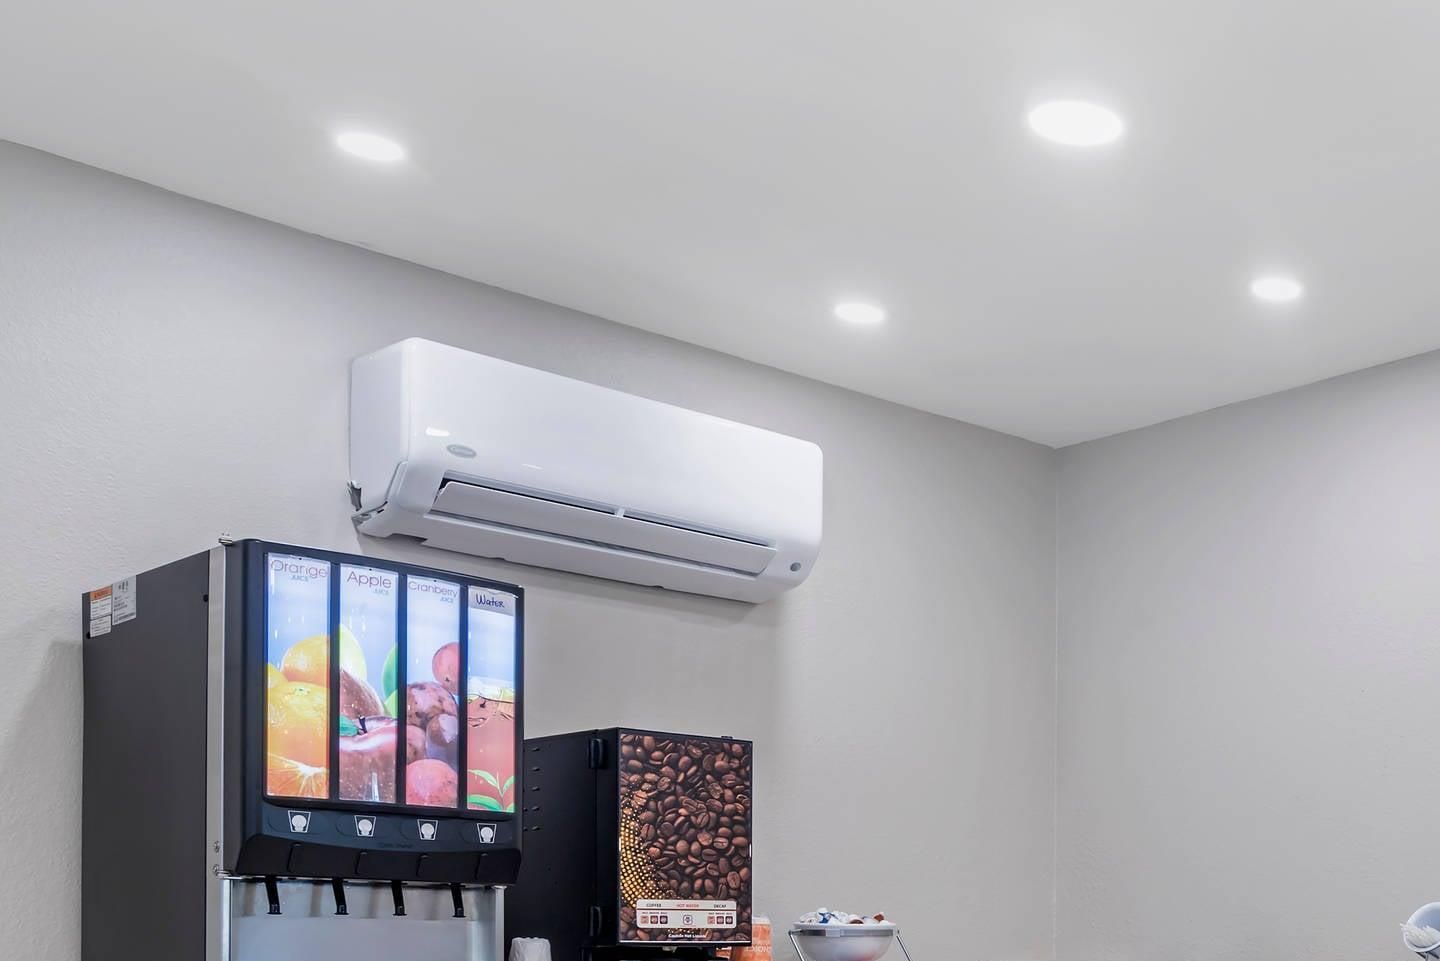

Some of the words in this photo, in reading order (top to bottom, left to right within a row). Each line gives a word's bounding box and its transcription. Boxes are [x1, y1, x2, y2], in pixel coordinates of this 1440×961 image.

[271, 560, 328, 579] Orange
[347, 571, 392, 588] Apple
[408, 581, 458, 598] Cranberry
[475, 593, 505, 608] Water
